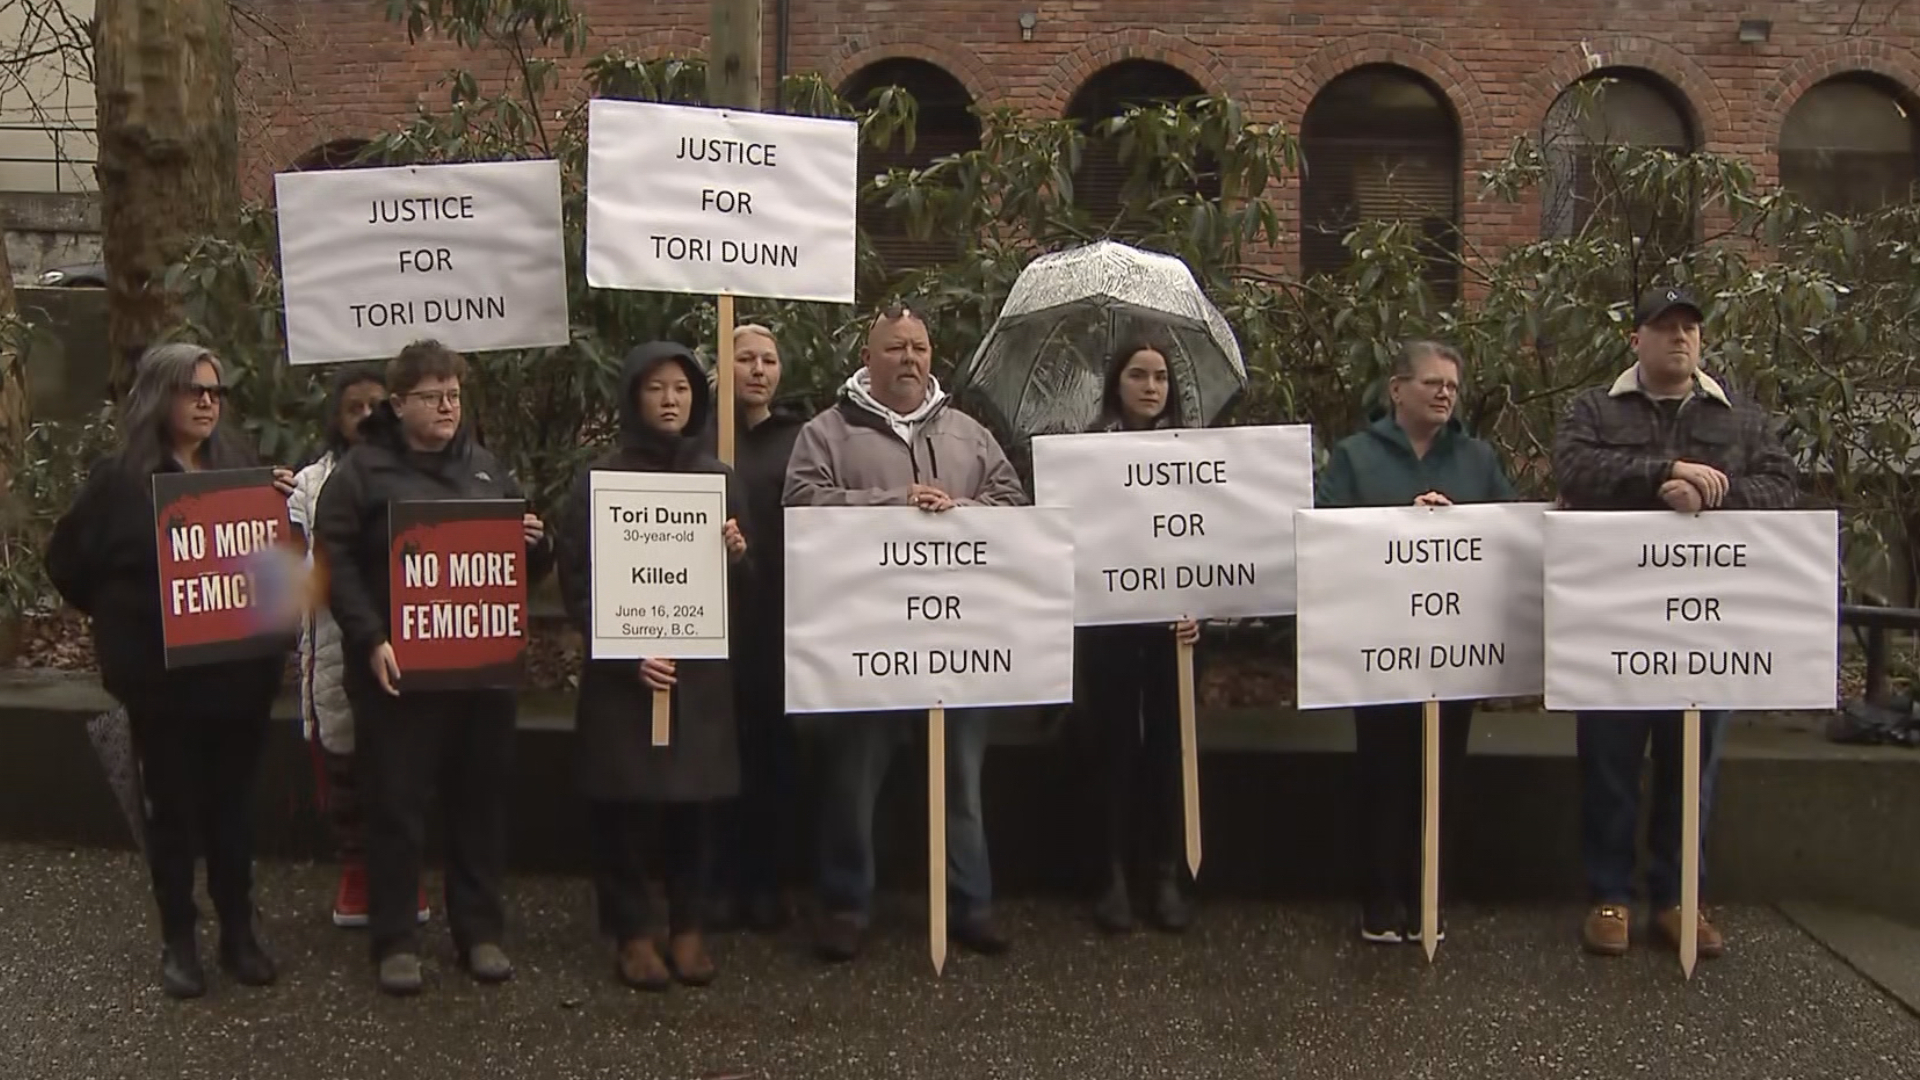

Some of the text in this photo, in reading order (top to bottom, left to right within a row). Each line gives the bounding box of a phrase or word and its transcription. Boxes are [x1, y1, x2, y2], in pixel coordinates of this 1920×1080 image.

[676, 136, 777, 167] JUSTICE
[368, 195, 474, 224] JUSTICE
[702, 189, 752, 215] FOR
[399, 248, 453, 273] FOR
[650, 235, 798, 268] TORI DUNN
[349, 296, 505, 328] TORI DUNN
[1124, 460, 1227, 487] JUSTICE
[609, 506, 707, 524] Tori Dunn
[1153, 513, 1205, 538] FOR
[171, 525, 206, 562] NO
[623, 529, 694, 544] 30-year-old
[879, 541, 988, 566] JUSTICE
[1384, 537, 1482, 565] JUSTICE
[1637, 544, 1747, 568] JUSTICE
[405, 552, 518, 589] NO MORE
[632, 567, 688, 585] Killed
[1102, 562, 1255, 592] TORI DUNN
[171, 573, 257, 615] FEMICI
[1411, 592, 1460, 617] FOR
[615, 605, 704, 619] June 16, 2024
[907, 595, 961, 621] FOR
[1666, 597, 1721, 622] FOR
[402, 603, 523, 640] FEMICIDE
[622, 623, 698, 637] Surrey, B.C.
[852, 648, 1011, 677] TORI DUNN
[1361, 642, 1505, 672] TORI DUNN
[1611, 651, 1772, 676] TORI DUNN
